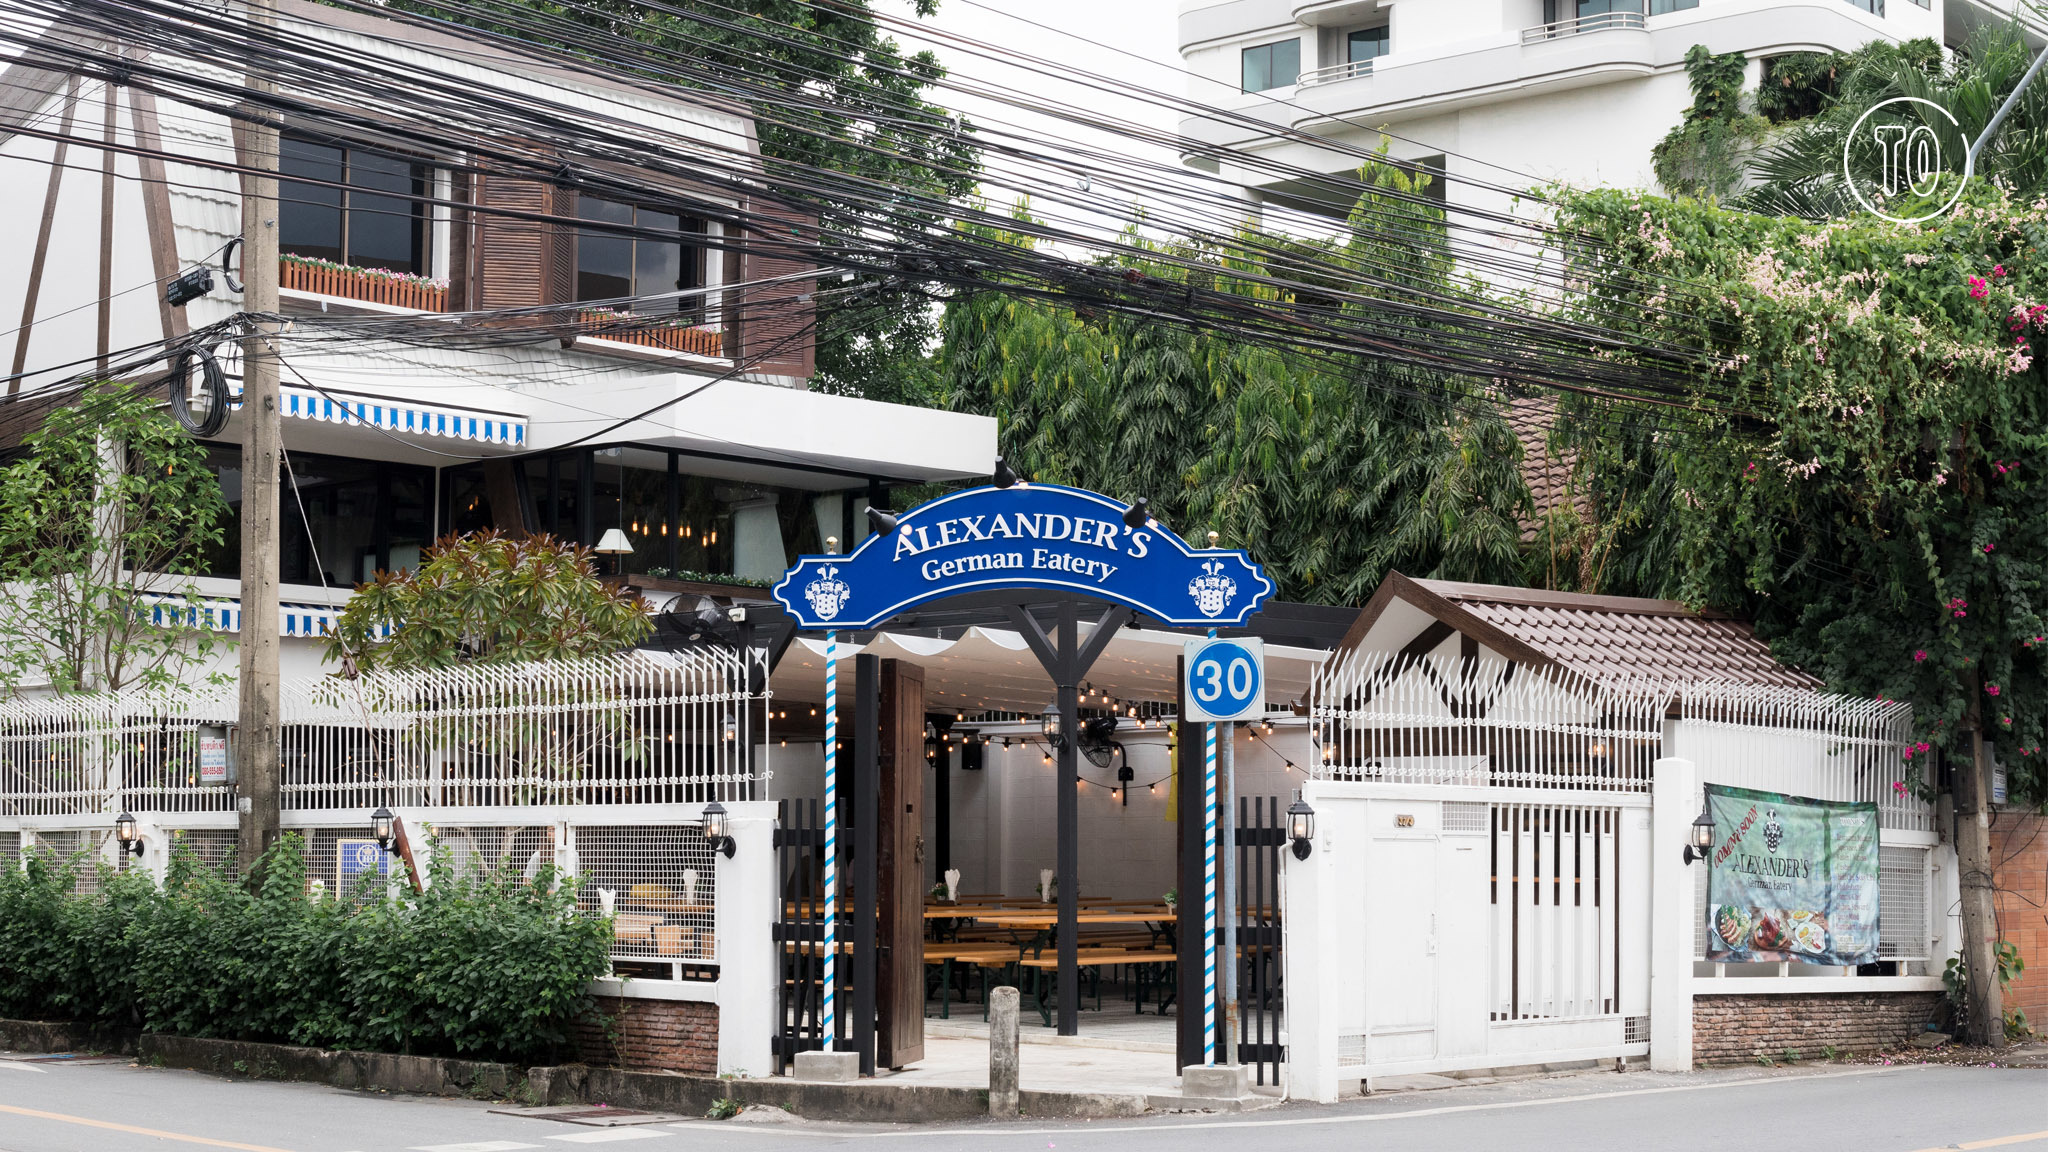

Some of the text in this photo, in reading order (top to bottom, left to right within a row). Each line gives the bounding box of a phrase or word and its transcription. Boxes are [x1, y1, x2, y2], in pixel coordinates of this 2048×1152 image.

[892, 512, 1152, 562] ALEXANDER'S
[921, 548, 1118, 583] German Eatery
[1196, 659, 1253, 702] 30
[1740, 804, 1759, 836] SOON
[1732, 853, 1809, 879] ALEXANDER'S
[1773, 880, 1792, 891] Eatery
